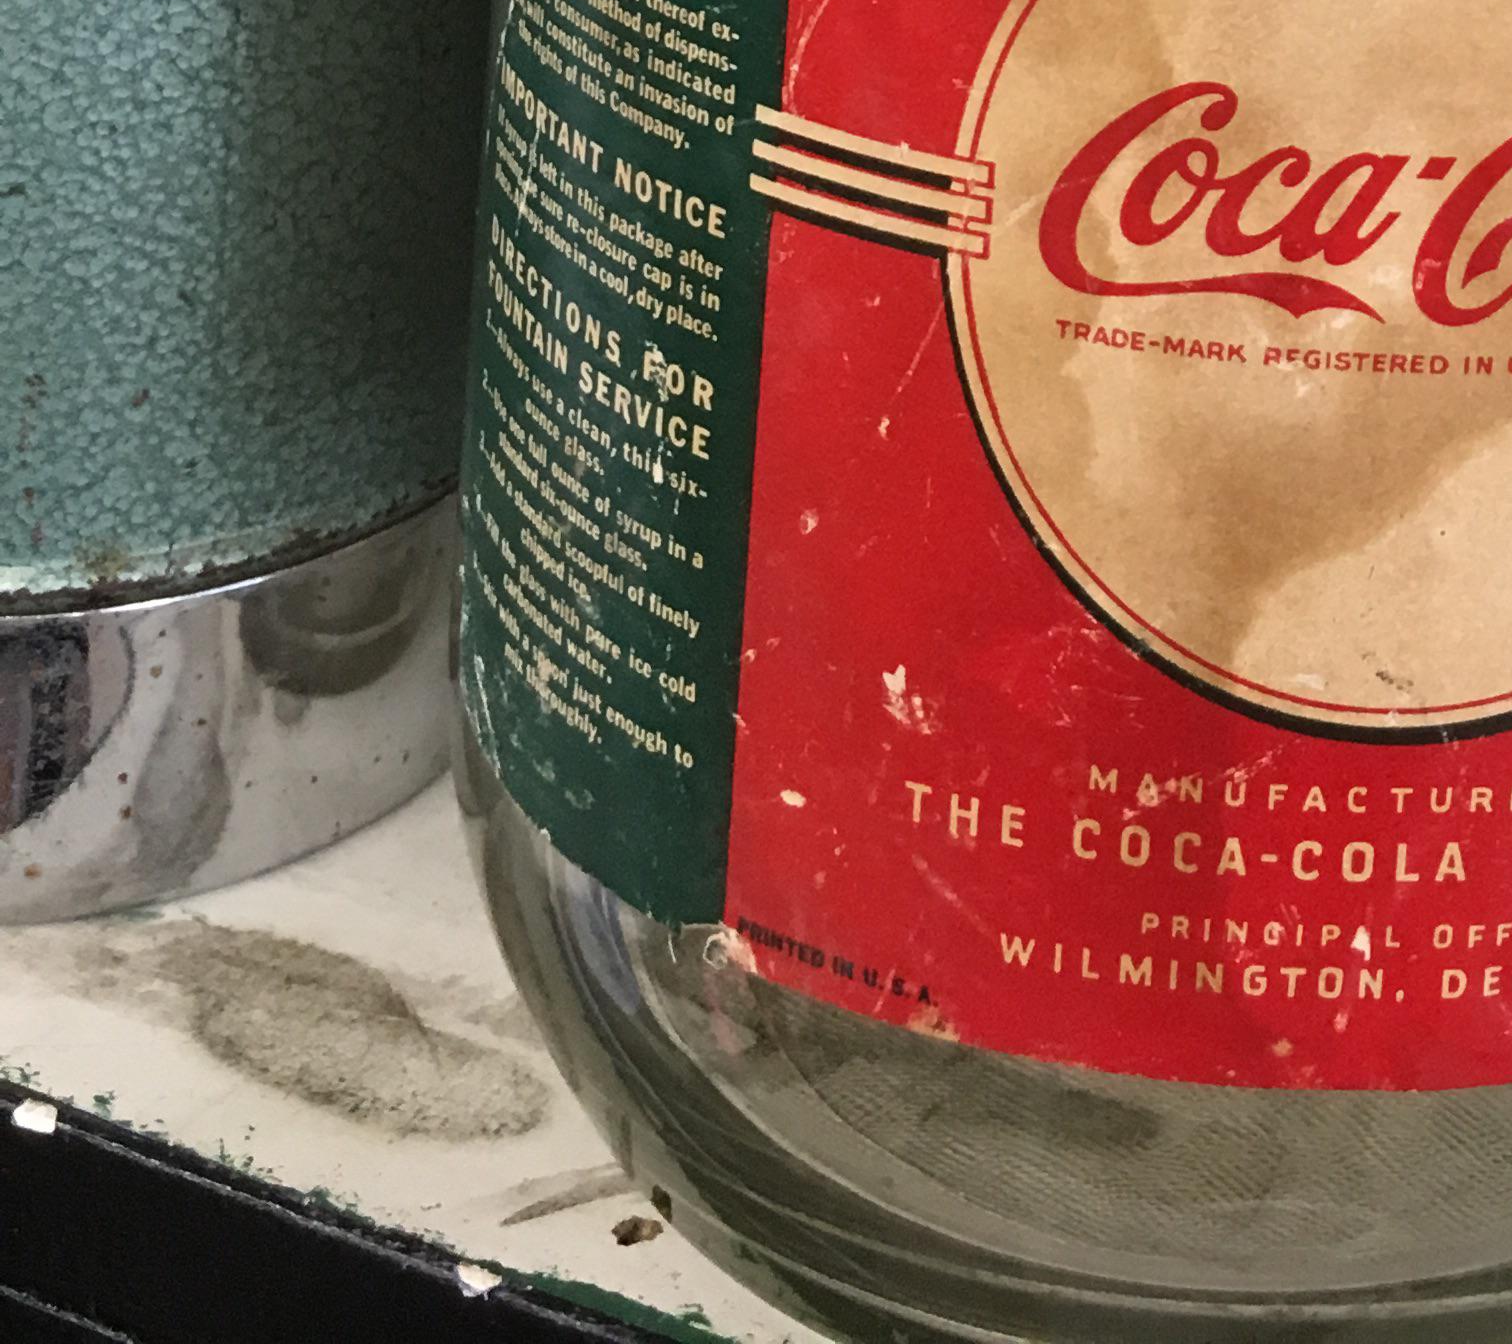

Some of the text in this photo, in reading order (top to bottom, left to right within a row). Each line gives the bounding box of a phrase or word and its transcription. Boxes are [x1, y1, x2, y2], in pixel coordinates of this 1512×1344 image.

[546, 20, 612, 78] constitute
[615, 68, 635, 91] an
[638, 75, 709, 127] invasion
[715, 114, 735, 136] of
[623, 41, 640, 63] as
[647, 48, 736, 105] indicated
[645, 21, 661, 43] of
[664, 28, 738, 72] dispens-
[711, 21, 740, 42] ex-
[501, 55, 604, 174] IMPORTANT
[614, 156, 727, 239] NOTICE
[565, 64, 577, 85] of
[580, 72, 606, 105] this
[609, 90, 690, 149] Company.
[540, 191, 720, 312] sure re-closure cap is in
[559, 171, 573, 200] in
[577, 187, 605, 222] this
[609, 212, 673, 259] package
[678, 248, 724, 281] after
[491, 213, 714, 411] DIRECTIONS FOR
[544, 225, 718, 342] store in a cool, dry place.
[489, 259, 711, 460] FOUNTAIN SERVICE
[1054, 319, 1248, 365] TRADE-MARK
[1262, 345, 1451, 376] REGISTERED
[1463, 354, 1494, 376] IN
[525, 397, 605, 476] ounce glass.
[532, 374, 708, 498] use a clean, six-
[551, 461, 590, 503] ounce
[594, 496, 611, 517] of
[616, 510, 662, 551] syrup
[667, 534, 687, 561] in
[692, 551, 704, 569] a
[603, 531, 648, 571] glass.
[565, 541, 625, 595] scoopful
[627, 585, 645, 606] of
[650, 593, 700, 639] finely
[550, 595, 580, 631] with
[629, 645, 652, 679] ice
[659, 672, 696, 703] cold
[567, 638, 612, 684] water.
[573, 677, 601, 714] just
[606, 706, 667, 755] enough
[674, 743, 694, 769] to
[904, 780, 1026, 848] THE
[1072, 818, 1466, 882] COCA-COLA
[737, 915, 939, 1008] PRINTED IN U.S.A.
[1000, 932, 1405, 1001] WILMINGTON,
